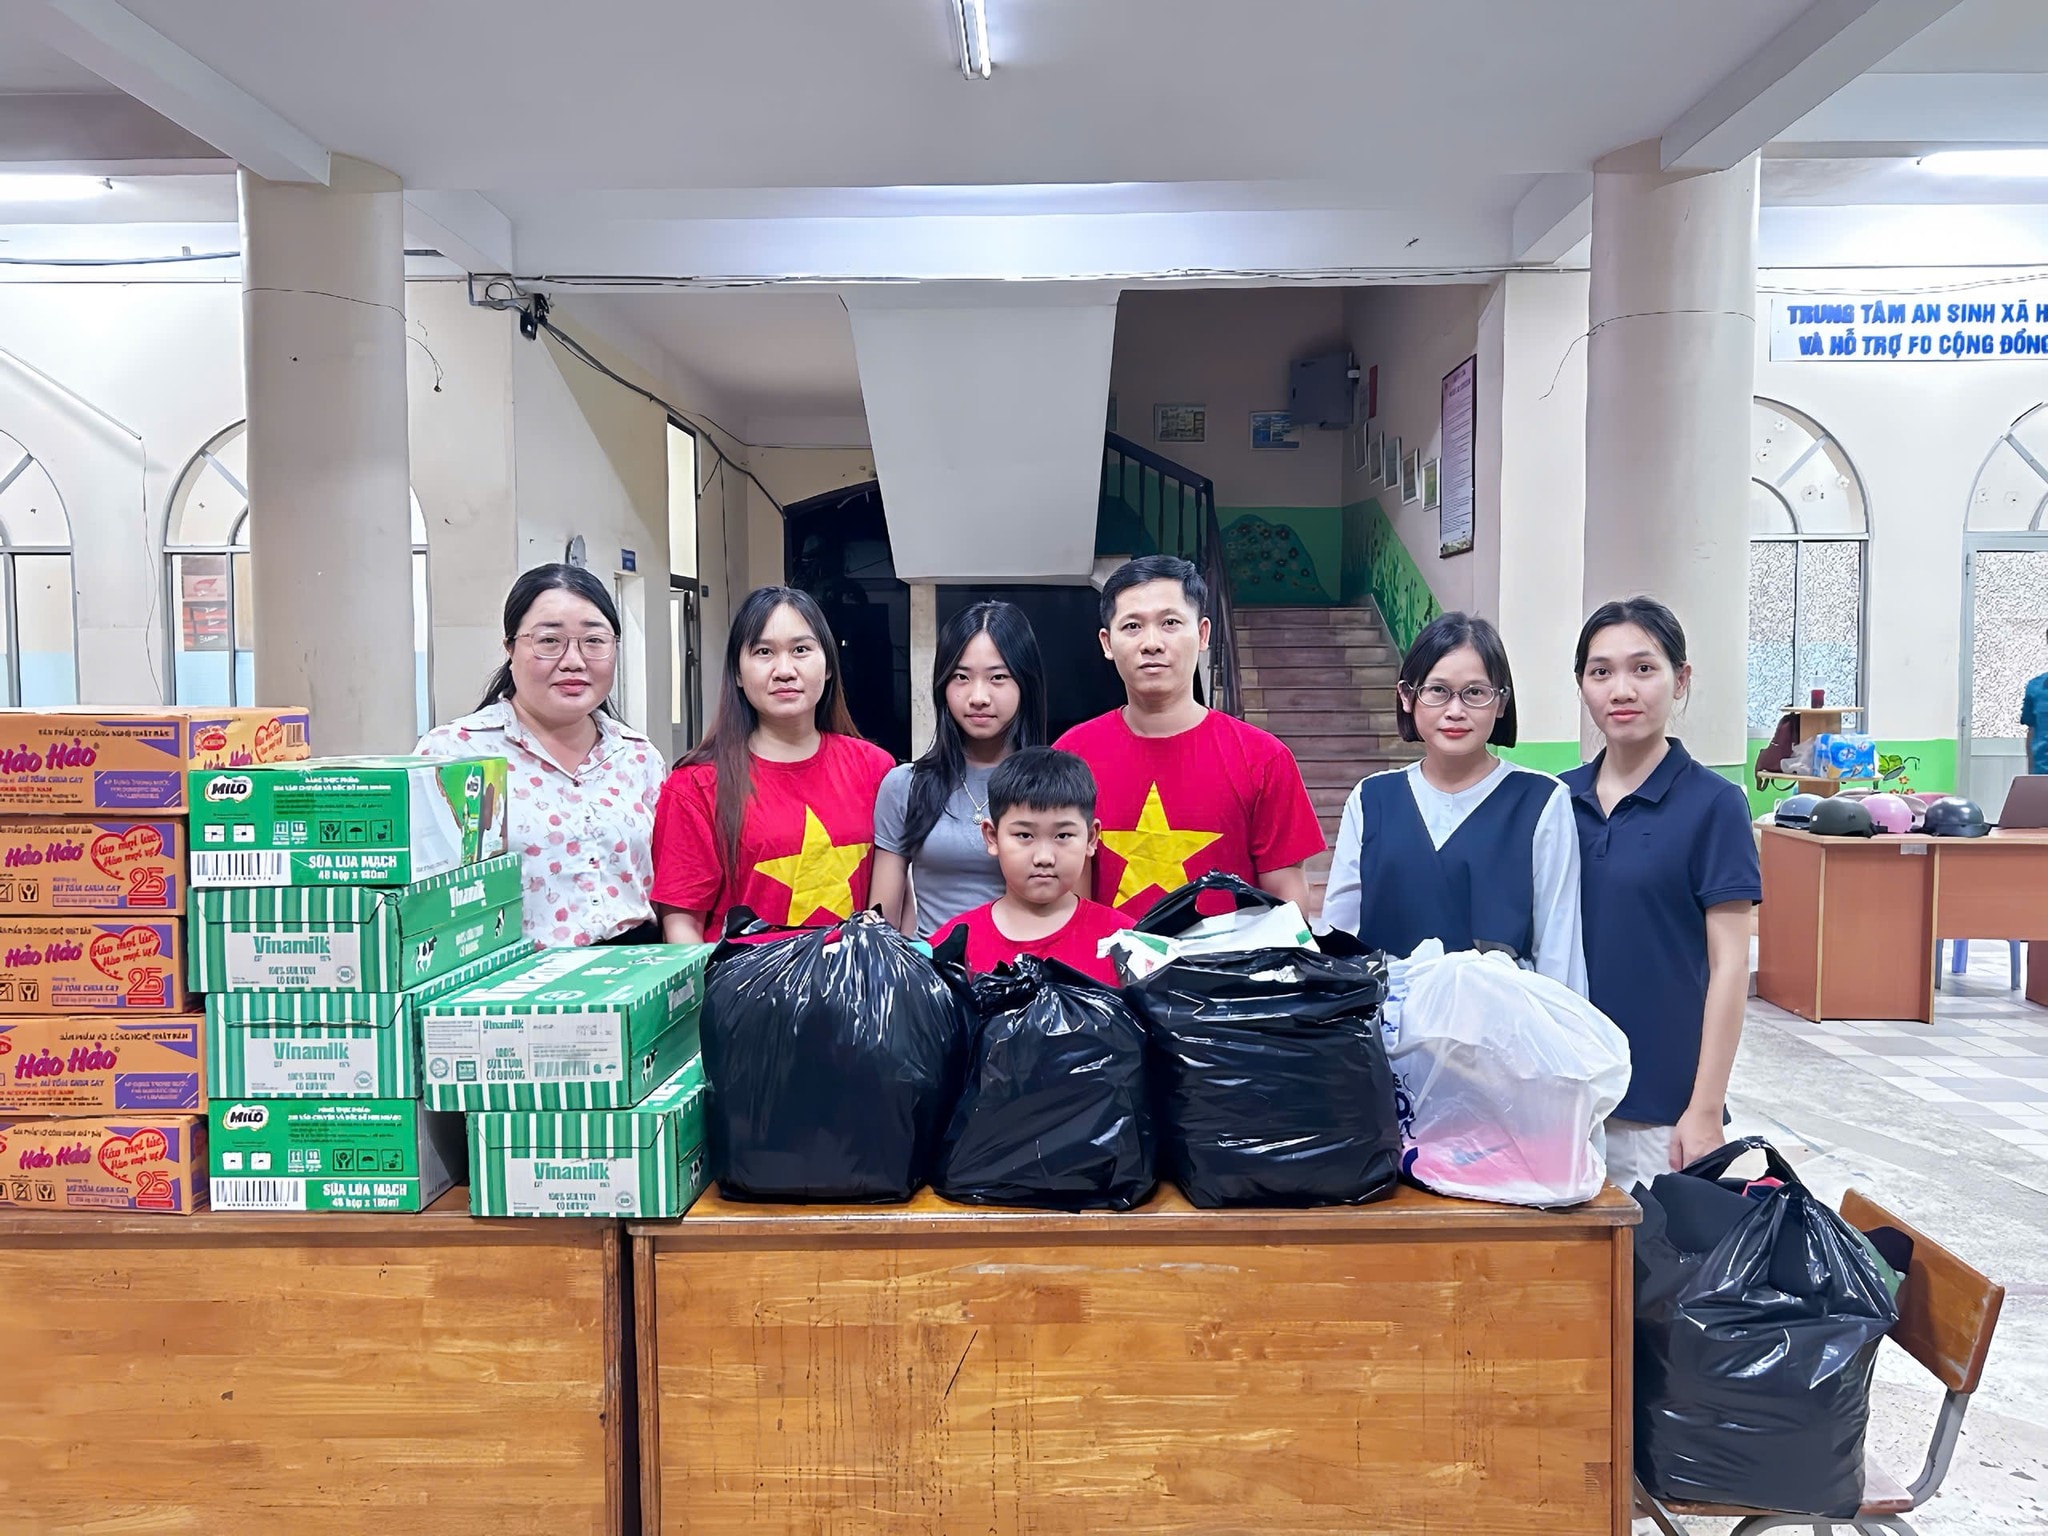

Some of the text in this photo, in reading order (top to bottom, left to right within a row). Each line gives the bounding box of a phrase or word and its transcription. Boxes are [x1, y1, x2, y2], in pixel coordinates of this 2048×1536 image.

[1787, 304, 1855, 325] TRUNG
[1861, 300, 1905, 324] TÂM
[1911, 303, 1941, 324] AN
[1947, 303, 1995, 324] SINH
[2001, 299, 2029, 324] XÃ
[1798, 331, 1825, 356] VÀ
[1829, 327, 1857, 356] HỖ
[1862, 333, 1903, 359] TRỢ
[1939, 330, 1993, 359] CỘNG
[46, 737, 97, 770] Hảo
[211, 783, 247, 795] MILO
[5, 838, 83, 868] Hảo Hảo
[128, 867, 168, 897] 25
[5, 939, 82, 968] Hảo Hảo
[253, 936, 331, 954] Vinamilk
[126, 967, 165, 996] 25
[482, 1019, 524, 1029] Vinamilk
[15, 1041, 117, 1079] Hảo Hảo
[273, 1042, 349, 1060] Vinamilk
[230, 1112, 264, 1123] MILO
[19, 1142, 91, 1170] Hảo Hảo
[136, 1171, 173, 1199] 25
[534, 1162, 610, 1180] Vinamilk
[323, 1182, 346, 1196] SỮA
[374, 1183, 407, 1198] MẠCH
